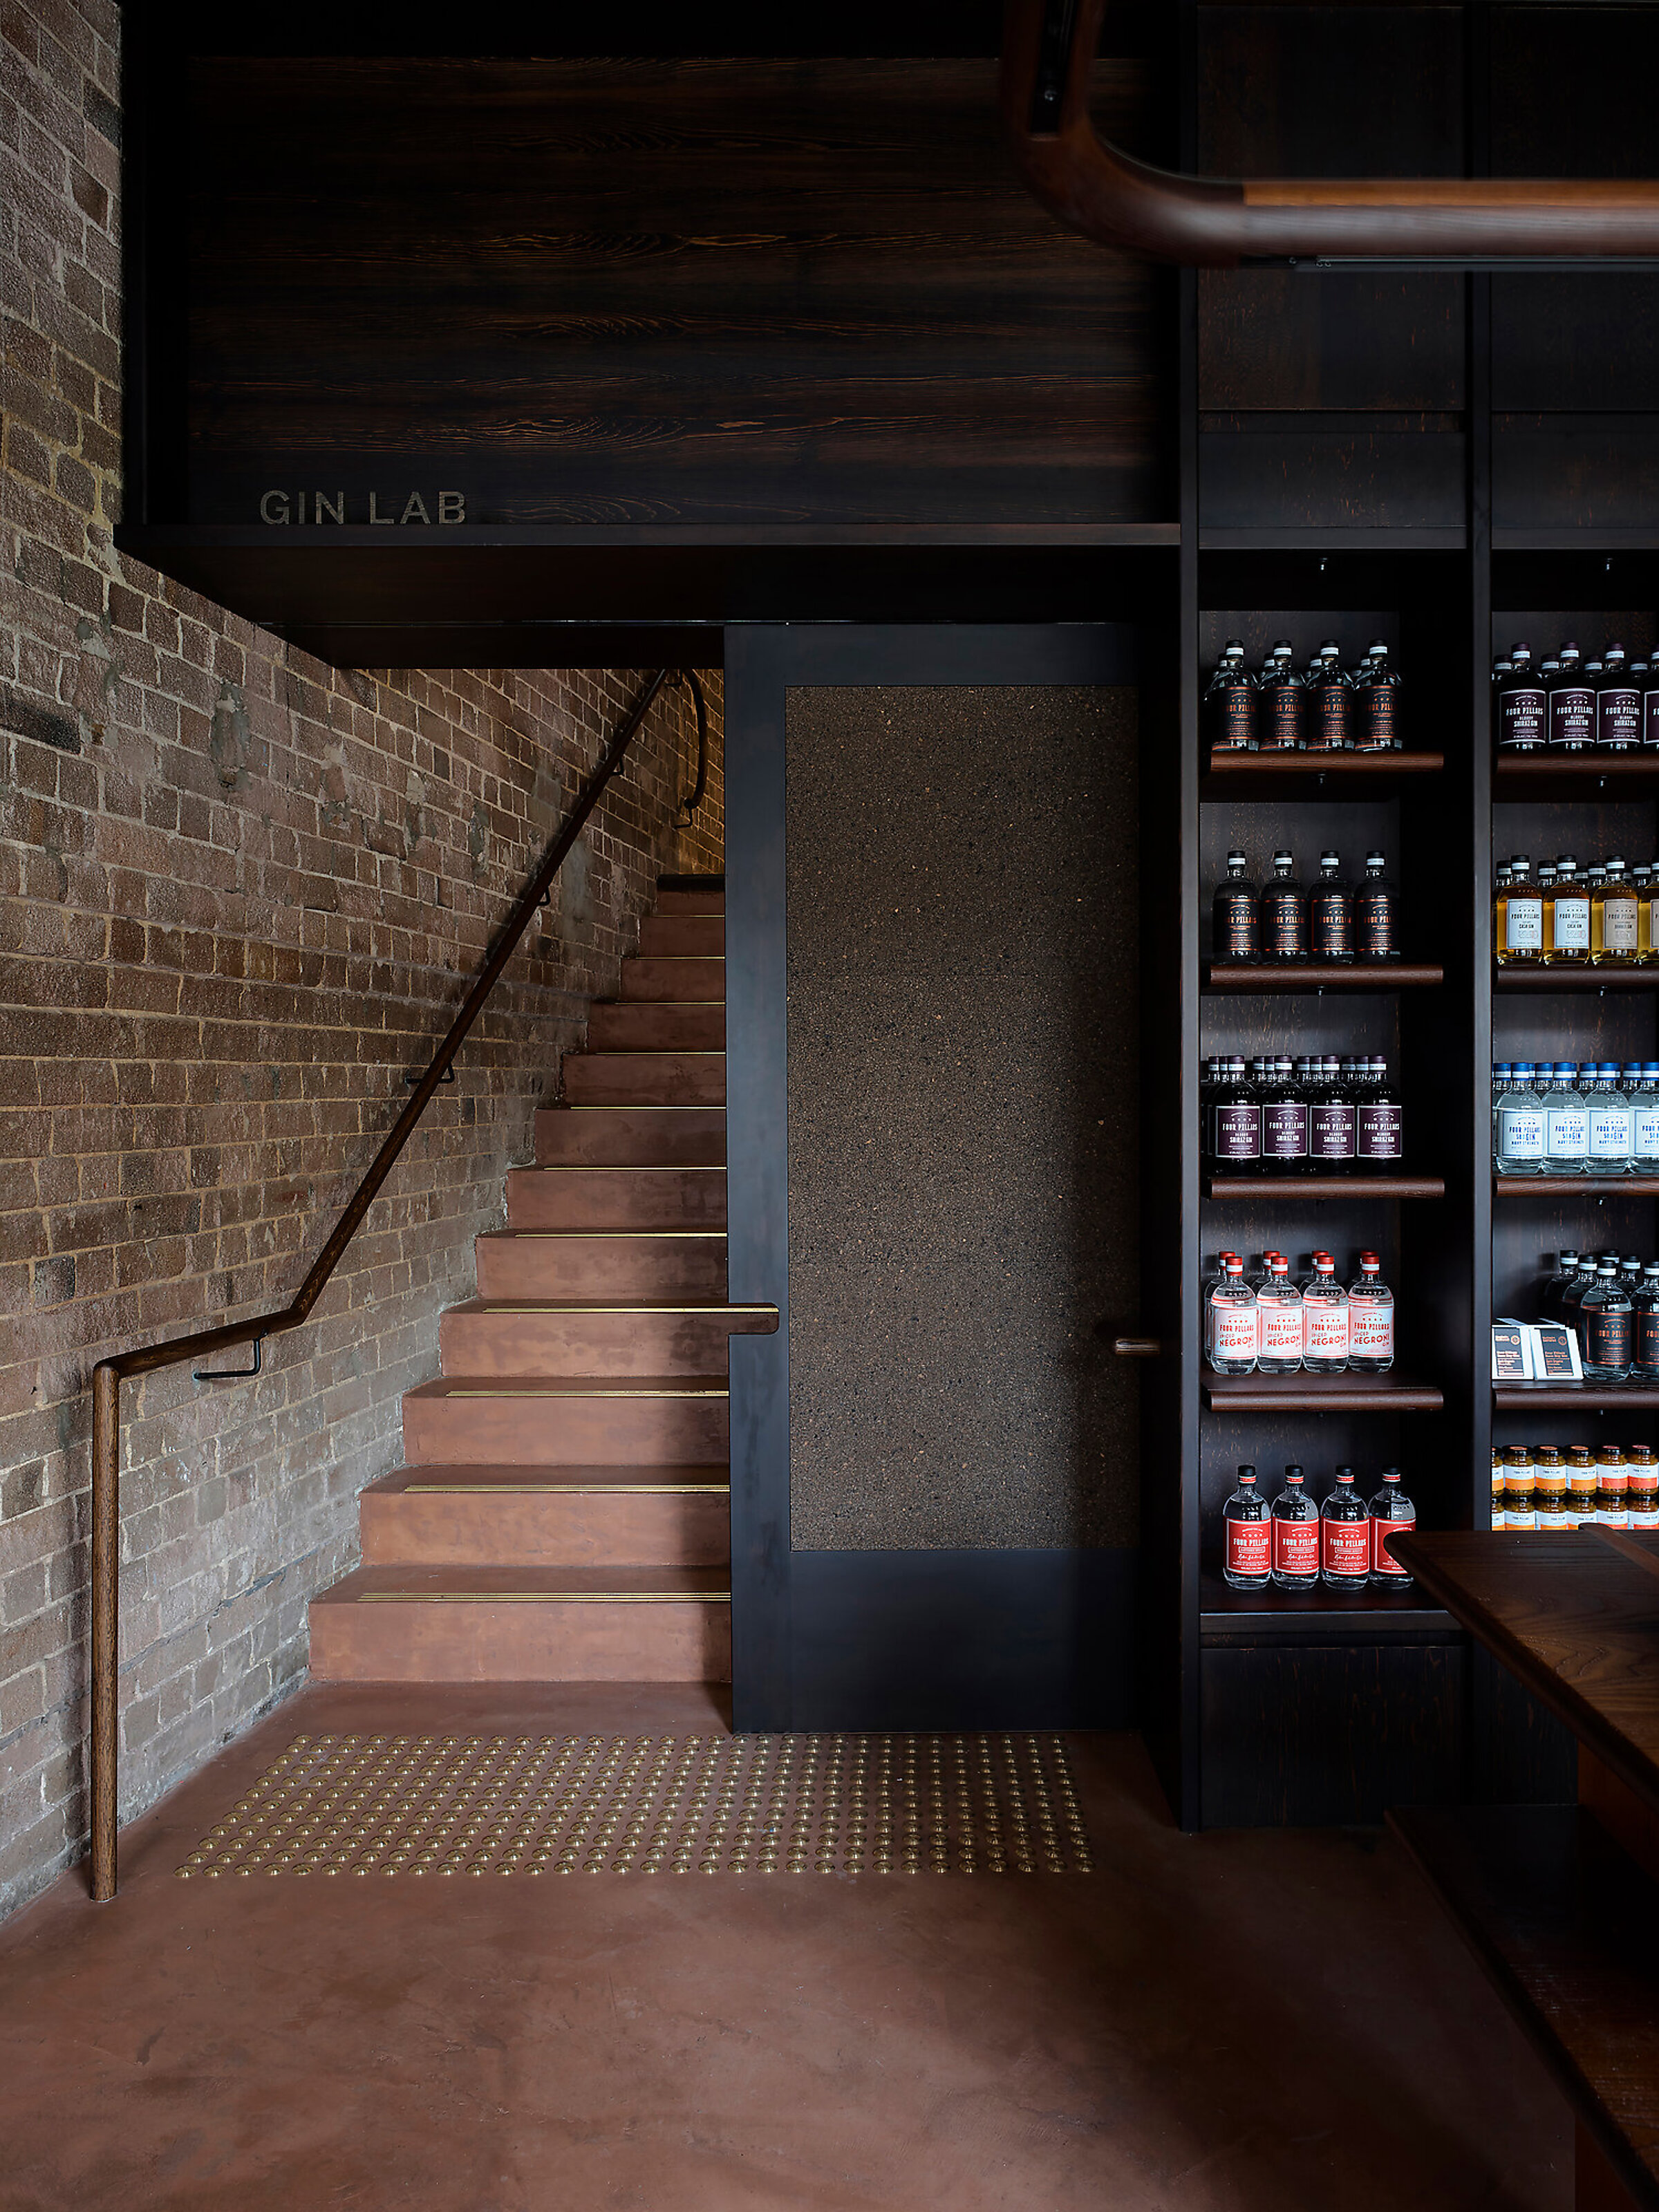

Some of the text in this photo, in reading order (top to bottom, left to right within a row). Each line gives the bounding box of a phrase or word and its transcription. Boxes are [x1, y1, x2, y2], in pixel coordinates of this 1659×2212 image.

[260, 489, 465, 525] GIN LAB
[1506, 707, 1520, 716] FOUR
[1557, 706, 1572, 715] FOUR
[1606, 706, 1621, 715] FOUR
[1354, 1322, 1367, 1330] FOUR
[1354, 1333, 1389, 1344] NEGRONI
[1233, 1538, 1247, 1546] FOUR
[1282, 1538, 1297, 1546] FOUR
[1345, 1539, 1366, 1547] PILLARS
